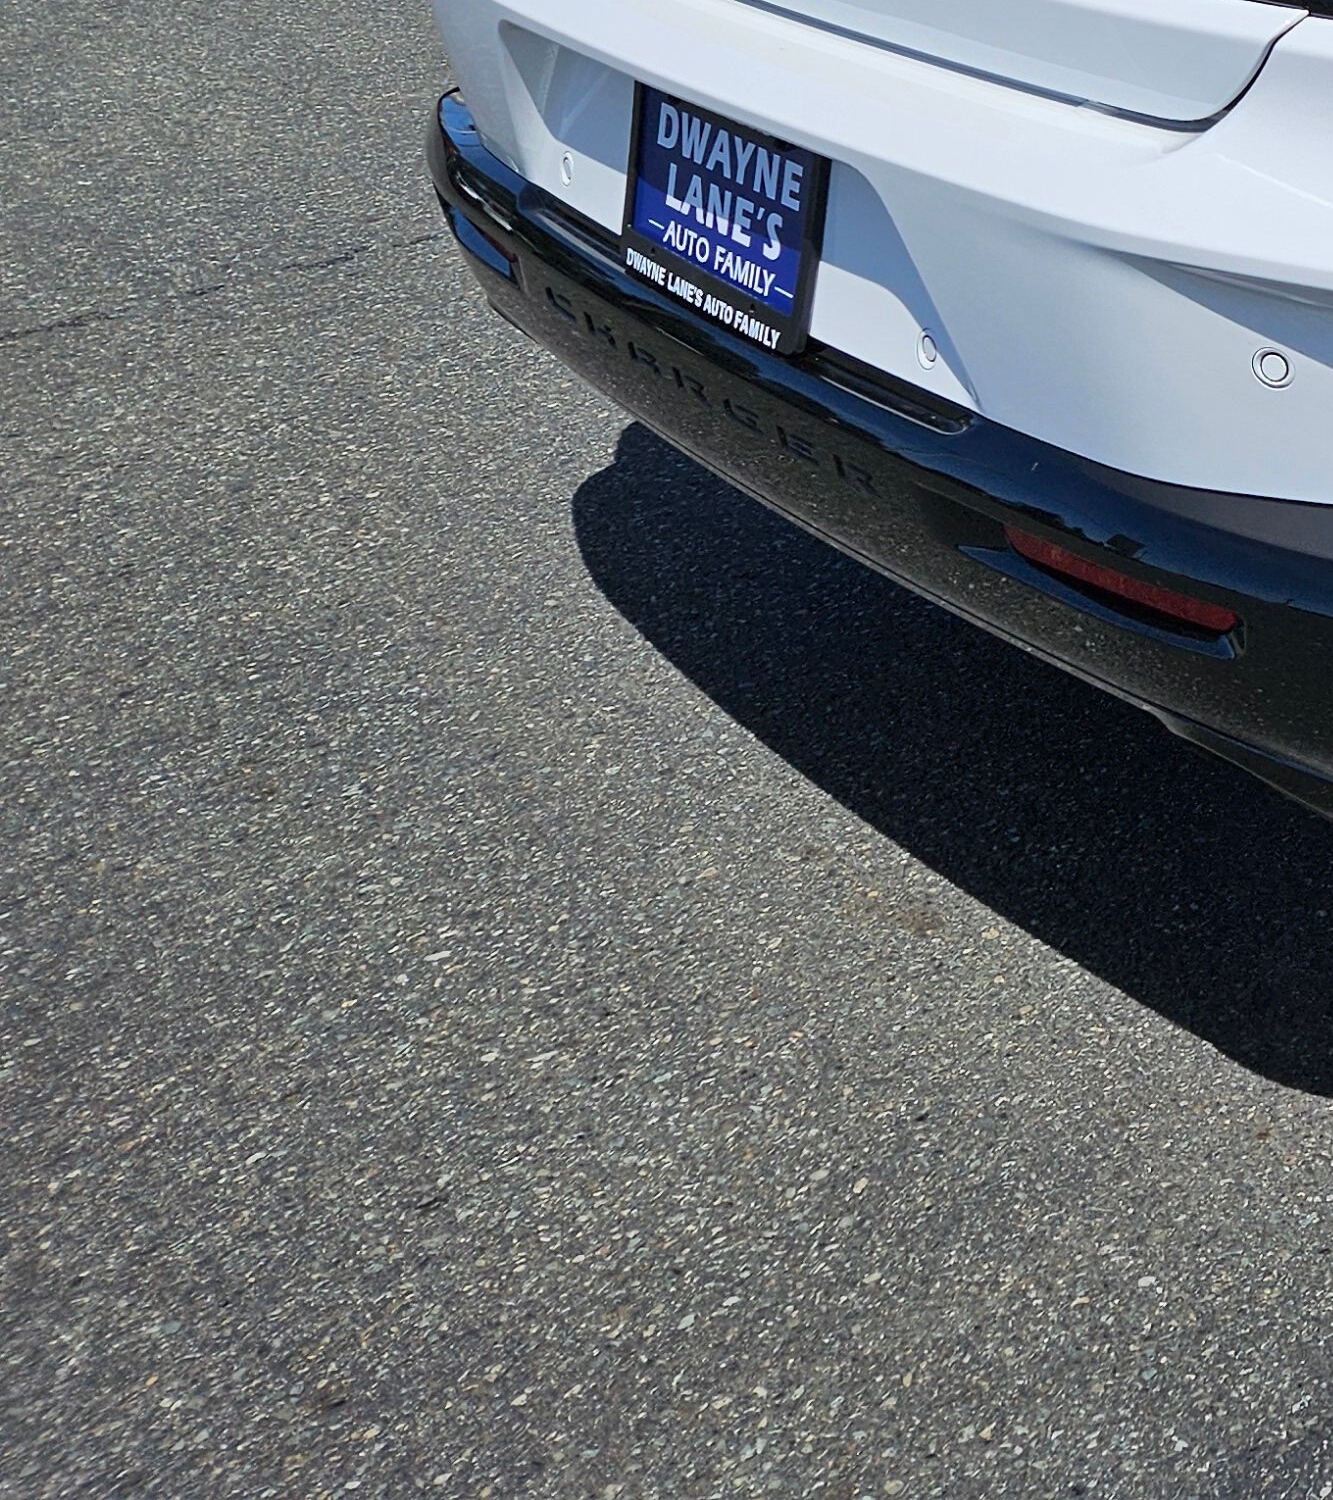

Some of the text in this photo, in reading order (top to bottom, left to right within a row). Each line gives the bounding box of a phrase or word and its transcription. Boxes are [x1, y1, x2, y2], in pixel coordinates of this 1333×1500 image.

[657, 102, 804, 212] DWAYNE
[663, 220, 776, 297] AUTO FAMILY
[665, 162, 784, 261] LANE'S
[626, 247, 781, 350] DWAYNE LANE'S AUTO FAMILY
